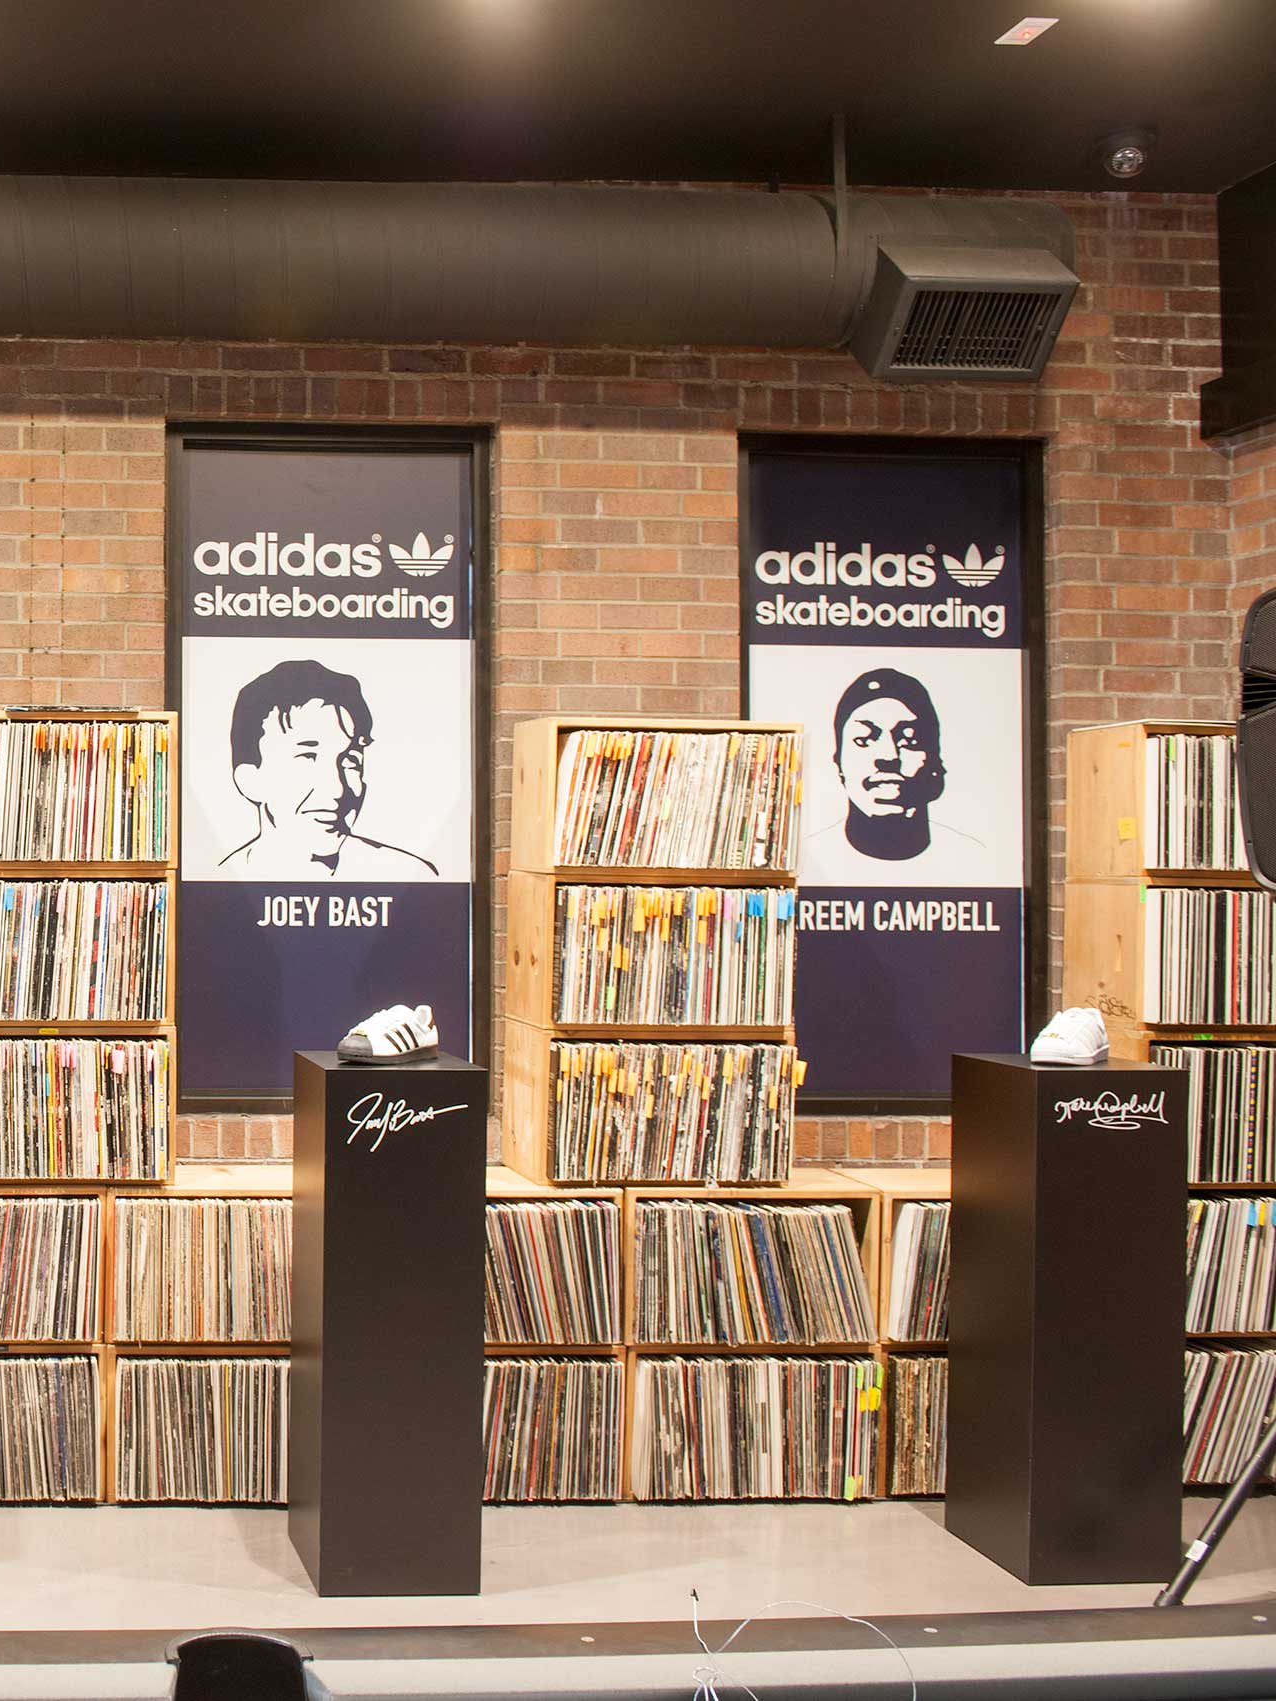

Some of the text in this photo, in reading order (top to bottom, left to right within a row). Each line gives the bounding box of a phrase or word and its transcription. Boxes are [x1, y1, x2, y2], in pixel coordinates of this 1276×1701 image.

[193, 532, 382, 578] adidas
[755, 542, 936, 588] adidas
[193, 585, 454, 629] skateboarding
[755, 594, 1006, 638] skateboarding
[256, 896, 393, 927] JOEY BAST
[797, 900, 1001, 932] REEM CAMPBELL
